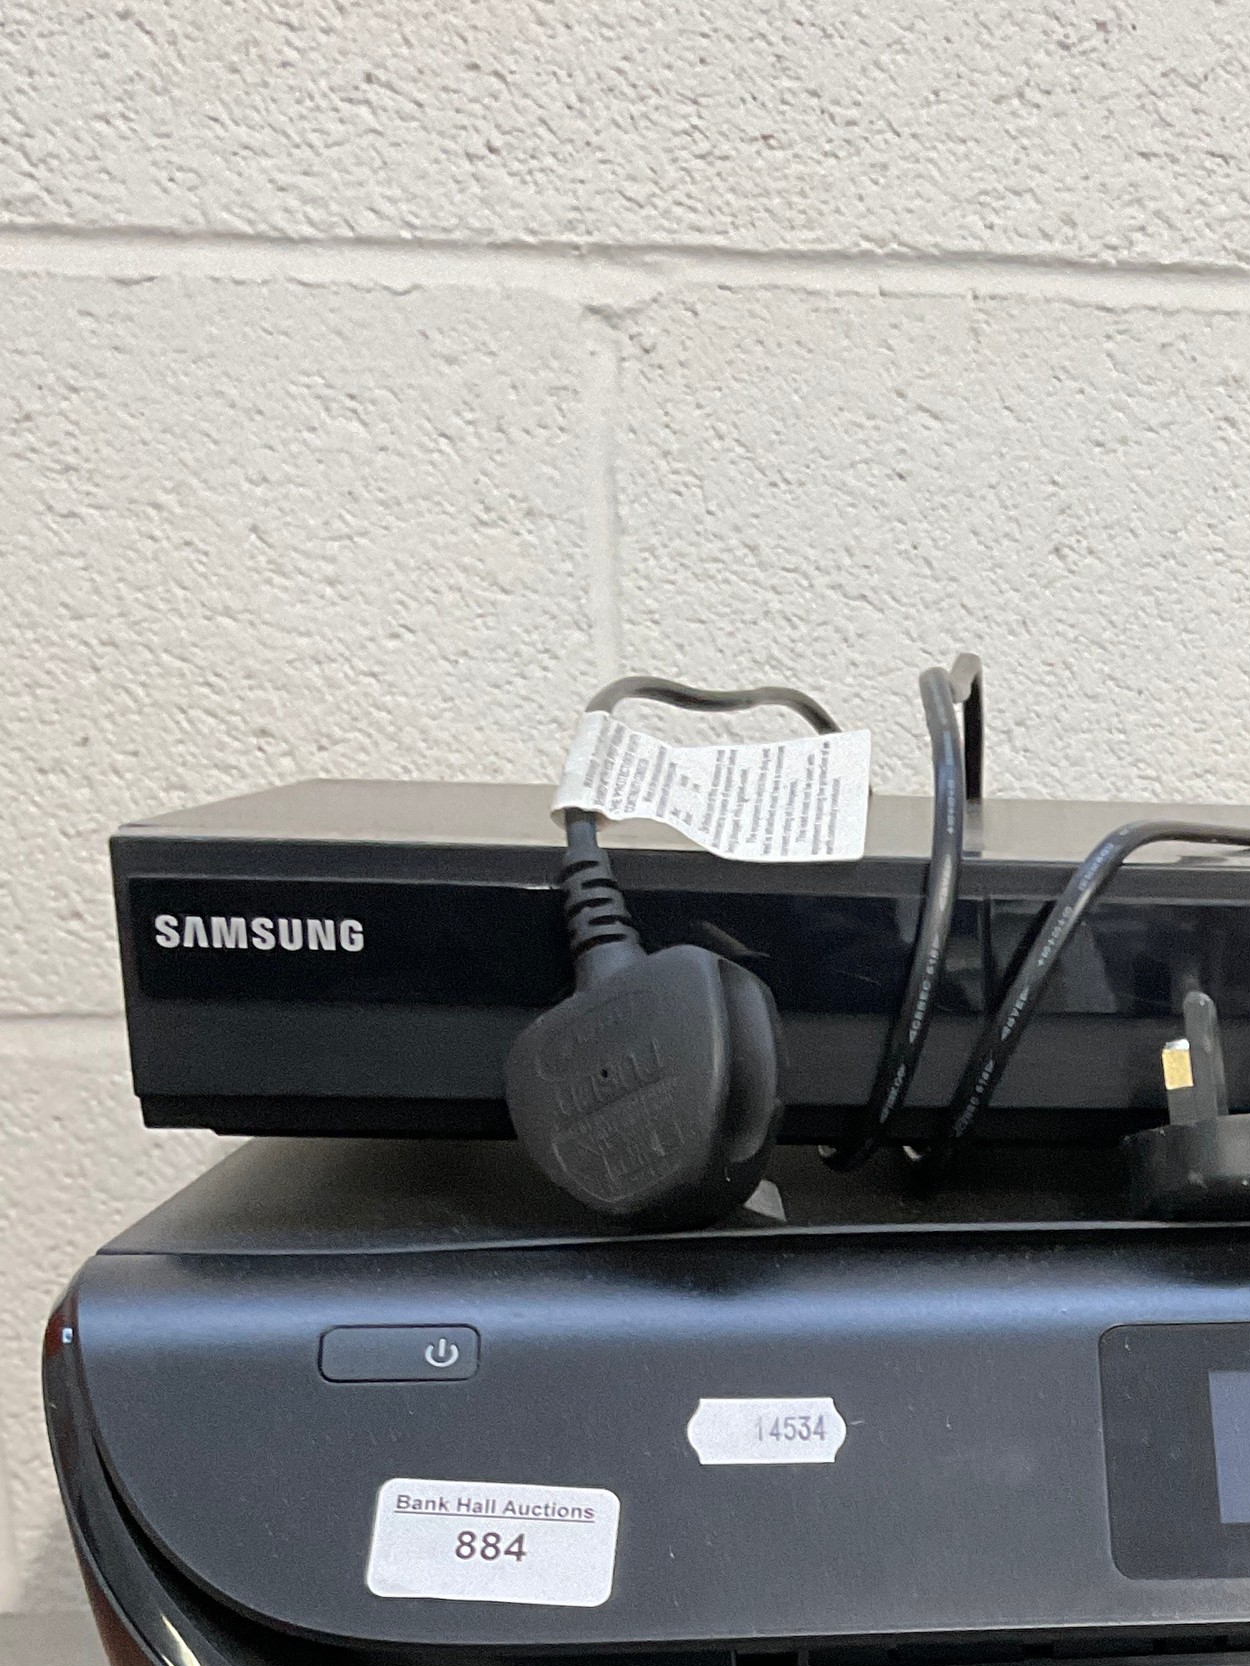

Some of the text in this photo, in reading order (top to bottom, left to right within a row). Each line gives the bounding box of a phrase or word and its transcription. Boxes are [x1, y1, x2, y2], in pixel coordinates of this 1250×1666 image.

[154, 914, 365, 951] SAMSUNG
[755, 1414, 827, 1442] 14534
[395, 1494, 596, 1519] Bank Hall Auctions
[455, 1531, 528, 1562] 884
